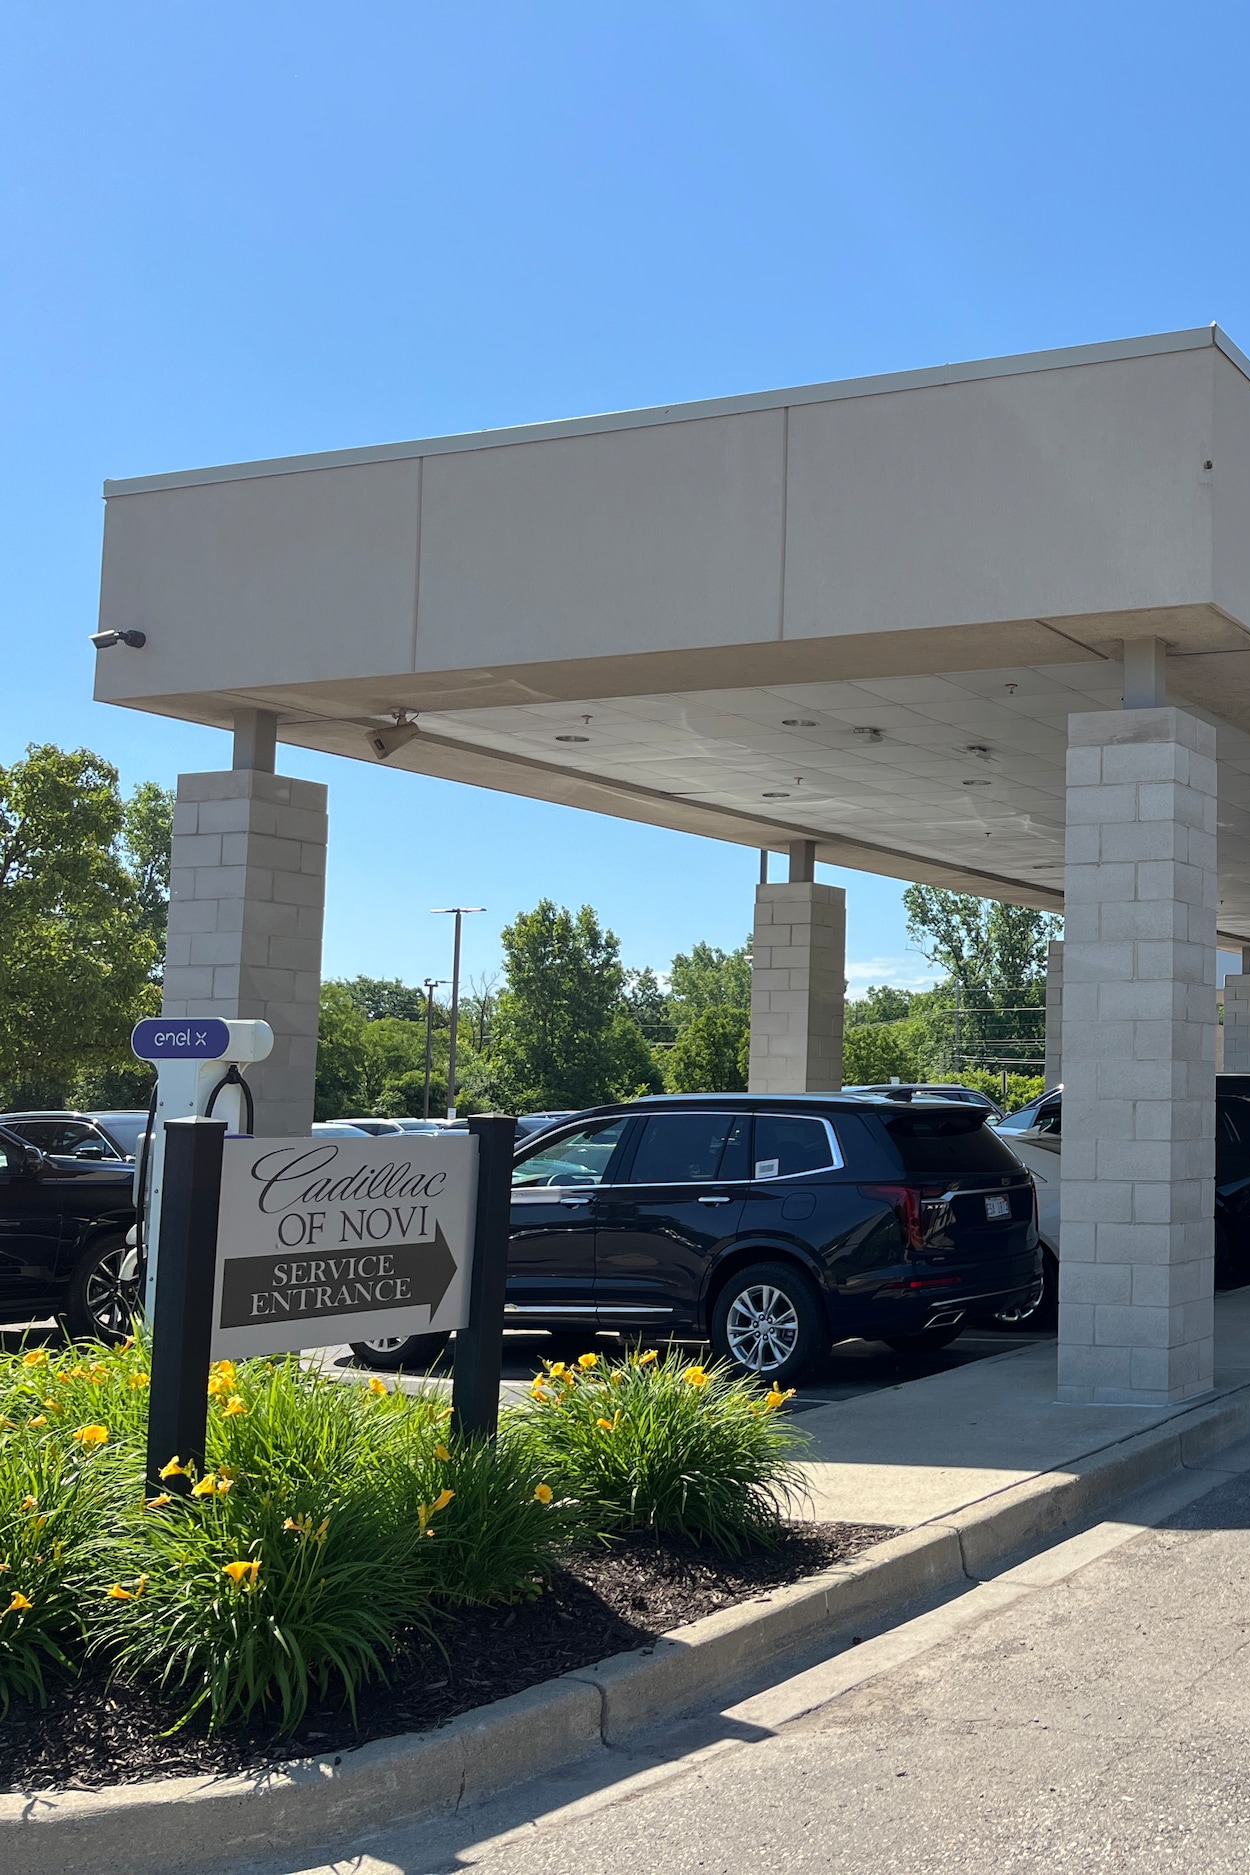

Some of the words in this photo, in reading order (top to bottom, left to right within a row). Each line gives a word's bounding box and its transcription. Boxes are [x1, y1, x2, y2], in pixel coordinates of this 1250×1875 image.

[154, 1028, 191, 1046] enel
[250, 1144, 447, 1214] Cadillac
[278, 1211, 326, 1246] OF
[339, 1205, 429, 1242] NOVI
[272, 1254, 395, 1287] SERVICE
[249, 1277, 412, 1317] ENTRANCE
